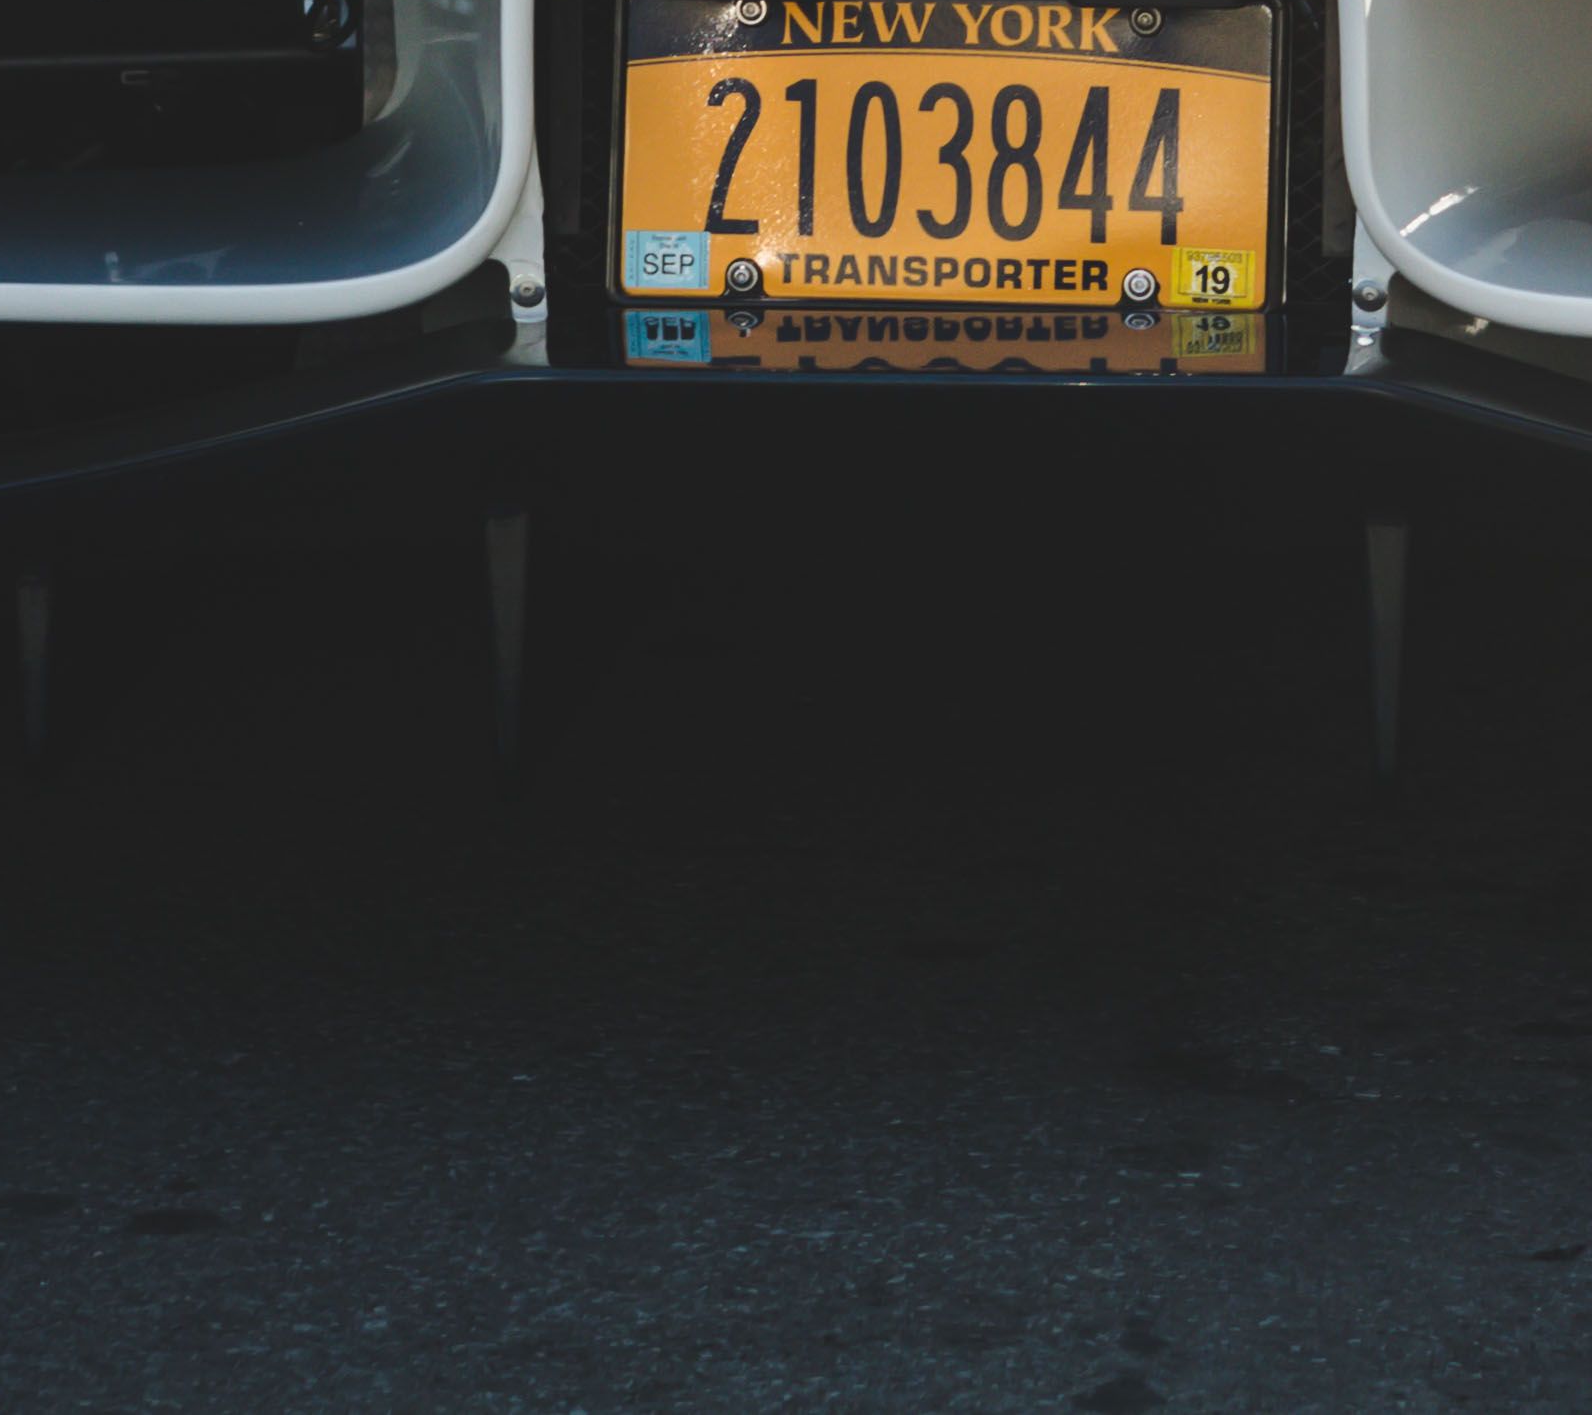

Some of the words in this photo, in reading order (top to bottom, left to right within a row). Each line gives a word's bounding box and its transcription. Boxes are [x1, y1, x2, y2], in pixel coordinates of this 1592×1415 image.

[780, 0, 938, 46] NEW
[951, 3, 1122, 54] YORK
[703, 76, 1185, 246] 2103844
[643, 252, 695, 276] SEP
[777, 252, 1110, 292] TRANSPORTER
[1195, 264, 1231, 296] 19
